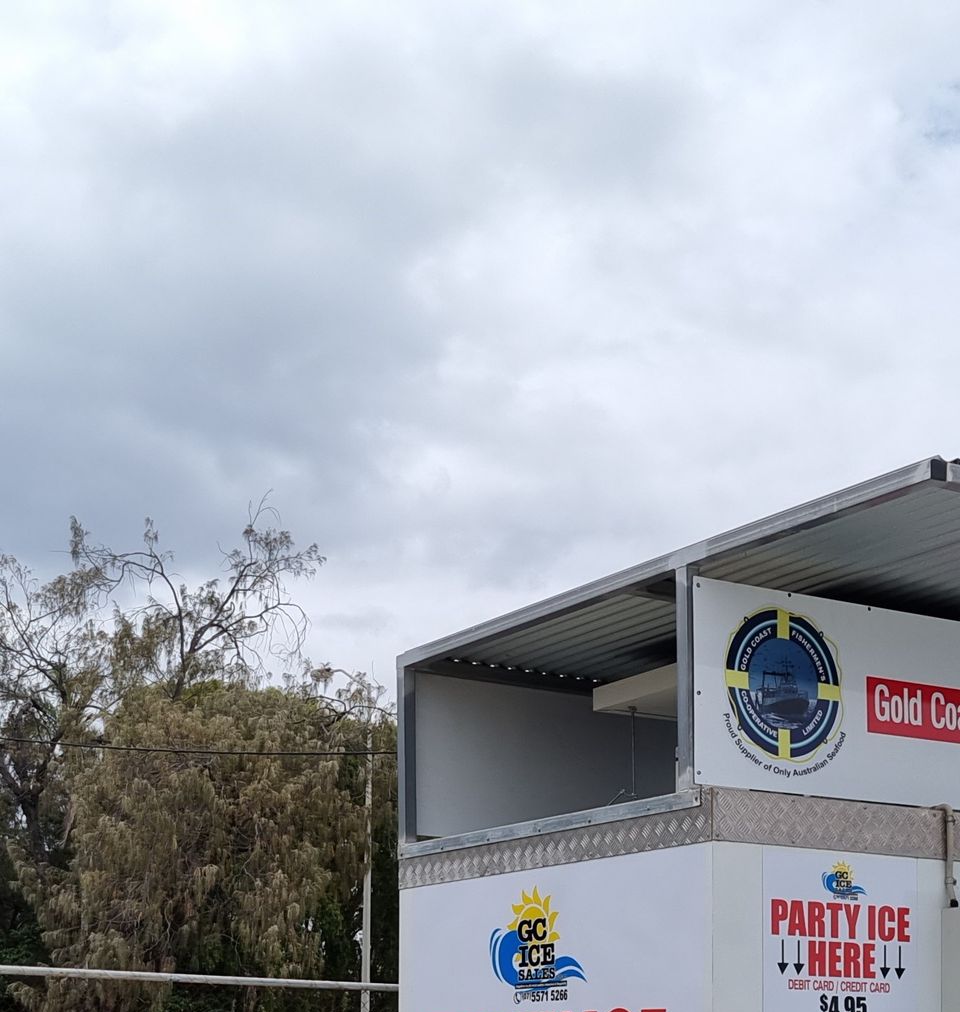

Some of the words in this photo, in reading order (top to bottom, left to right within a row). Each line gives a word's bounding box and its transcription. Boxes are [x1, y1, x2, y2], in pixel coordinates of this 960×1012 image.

[740, 646, 752, 671] GOLD
[751, 627, 772, 648] COAST
[791, 630, 826, 682] FISHERMEN'S
[741, 690, 778, 738] CO-OPERATIVE
[874, 683, 922, 726] Gold
[802, 710, 823, 736] LIMITED
[723, 712, 738, 740] Proud
[735, 738, 763, 767] Supplier
[763, 763, 772, 774] of
[773, 766, 792, 778] Only
[792, 755, 829, 776] Australian
[826, 731, 847, 761] Seafood
[835, 871, 848, 880] GC
[517, 918, 547, 942] GC
[771, 898, 861, 940] PARTY
[867, 905, 911, 943] ICE
[518, 943, 555, 967] ICE
[808, 940, 876, 979] HERE
[518, 967, 556, 981] SALES
[788, 979, 811, 990] DEBIT
[813, 980, 834, 992] CARD
[840, 981, 868, 992] CREDIT
[869, 982, 890, 993] CARD
[550, 989, 568, 1001] 5266
